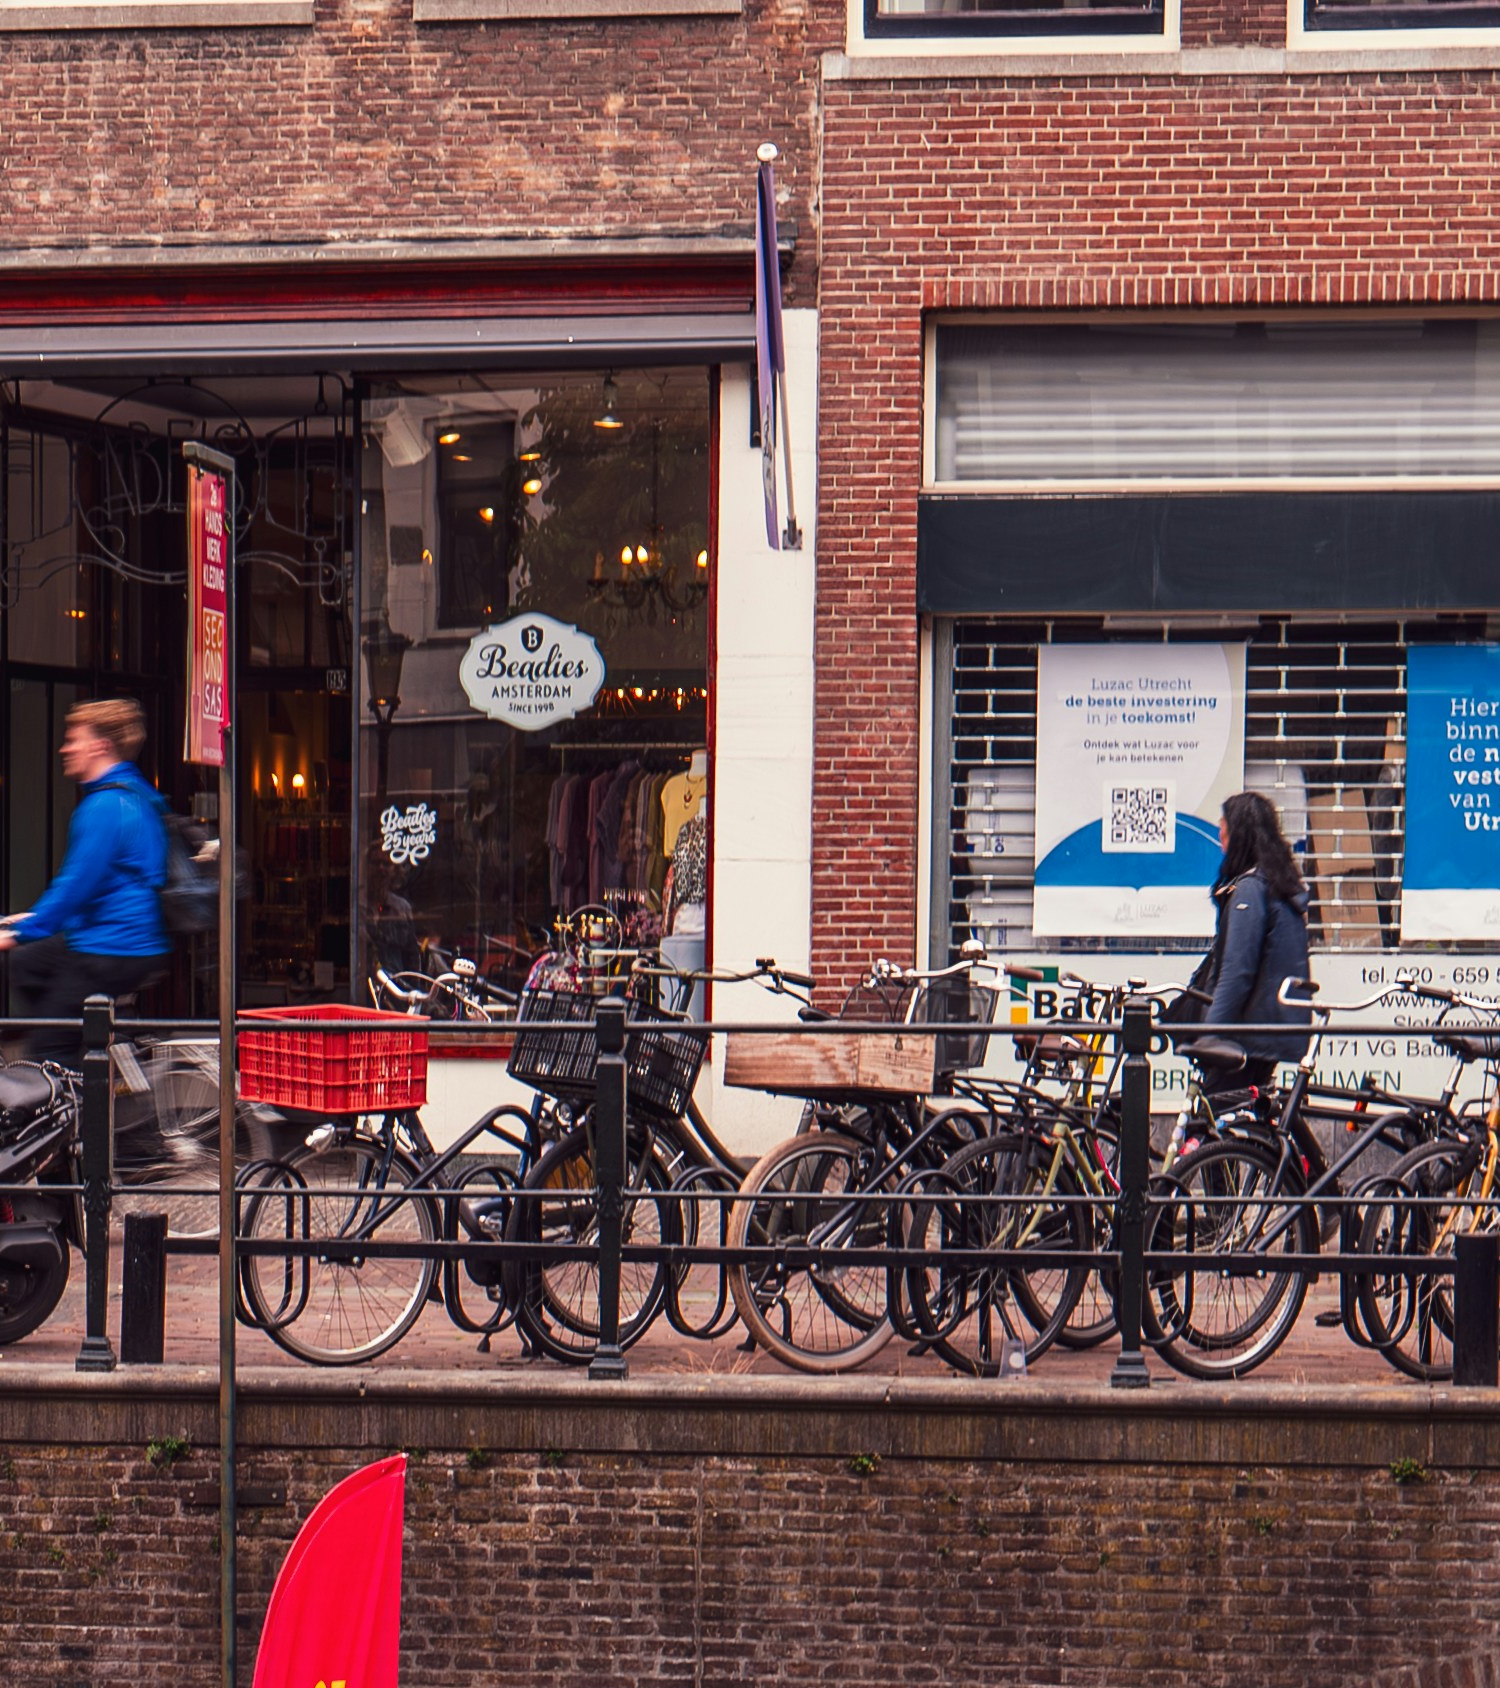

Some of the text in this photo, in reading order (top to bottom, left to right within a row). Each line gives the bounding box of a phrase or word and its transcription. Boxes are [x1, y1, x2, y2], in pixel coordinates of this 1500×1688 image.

[203, 563, 224, 592] KLEDING
[476, 644, 589, 682] Beadies
[492, 685, 572, 698] AMSTERDAM
[1092, 677, 1192, 691] Luzac Utrecht
[508, 703, 532, 713] SINCE
[1065, 695, 1217, 710] de beste investering
[1450, 698, 1499, 717] Hier
[1086, 711, 1196, 726] in je toekomst!
[1084, 739, 1119, 749] Ontdek
[1144, 739, 1174, 749] Luzac
[1177, 741, 1200, 749] voor
[1109, 753, 1127, 763] kan
[1449, 743, 1476, 763] de
[1449, 793, 1491, 808] van
[382, 831, 402, 851] 25
[1362, 966, 1389, 984] tel.
[1452, 967, 1489, 984] 659
[1367, 1040, 1396, 1056] VG
